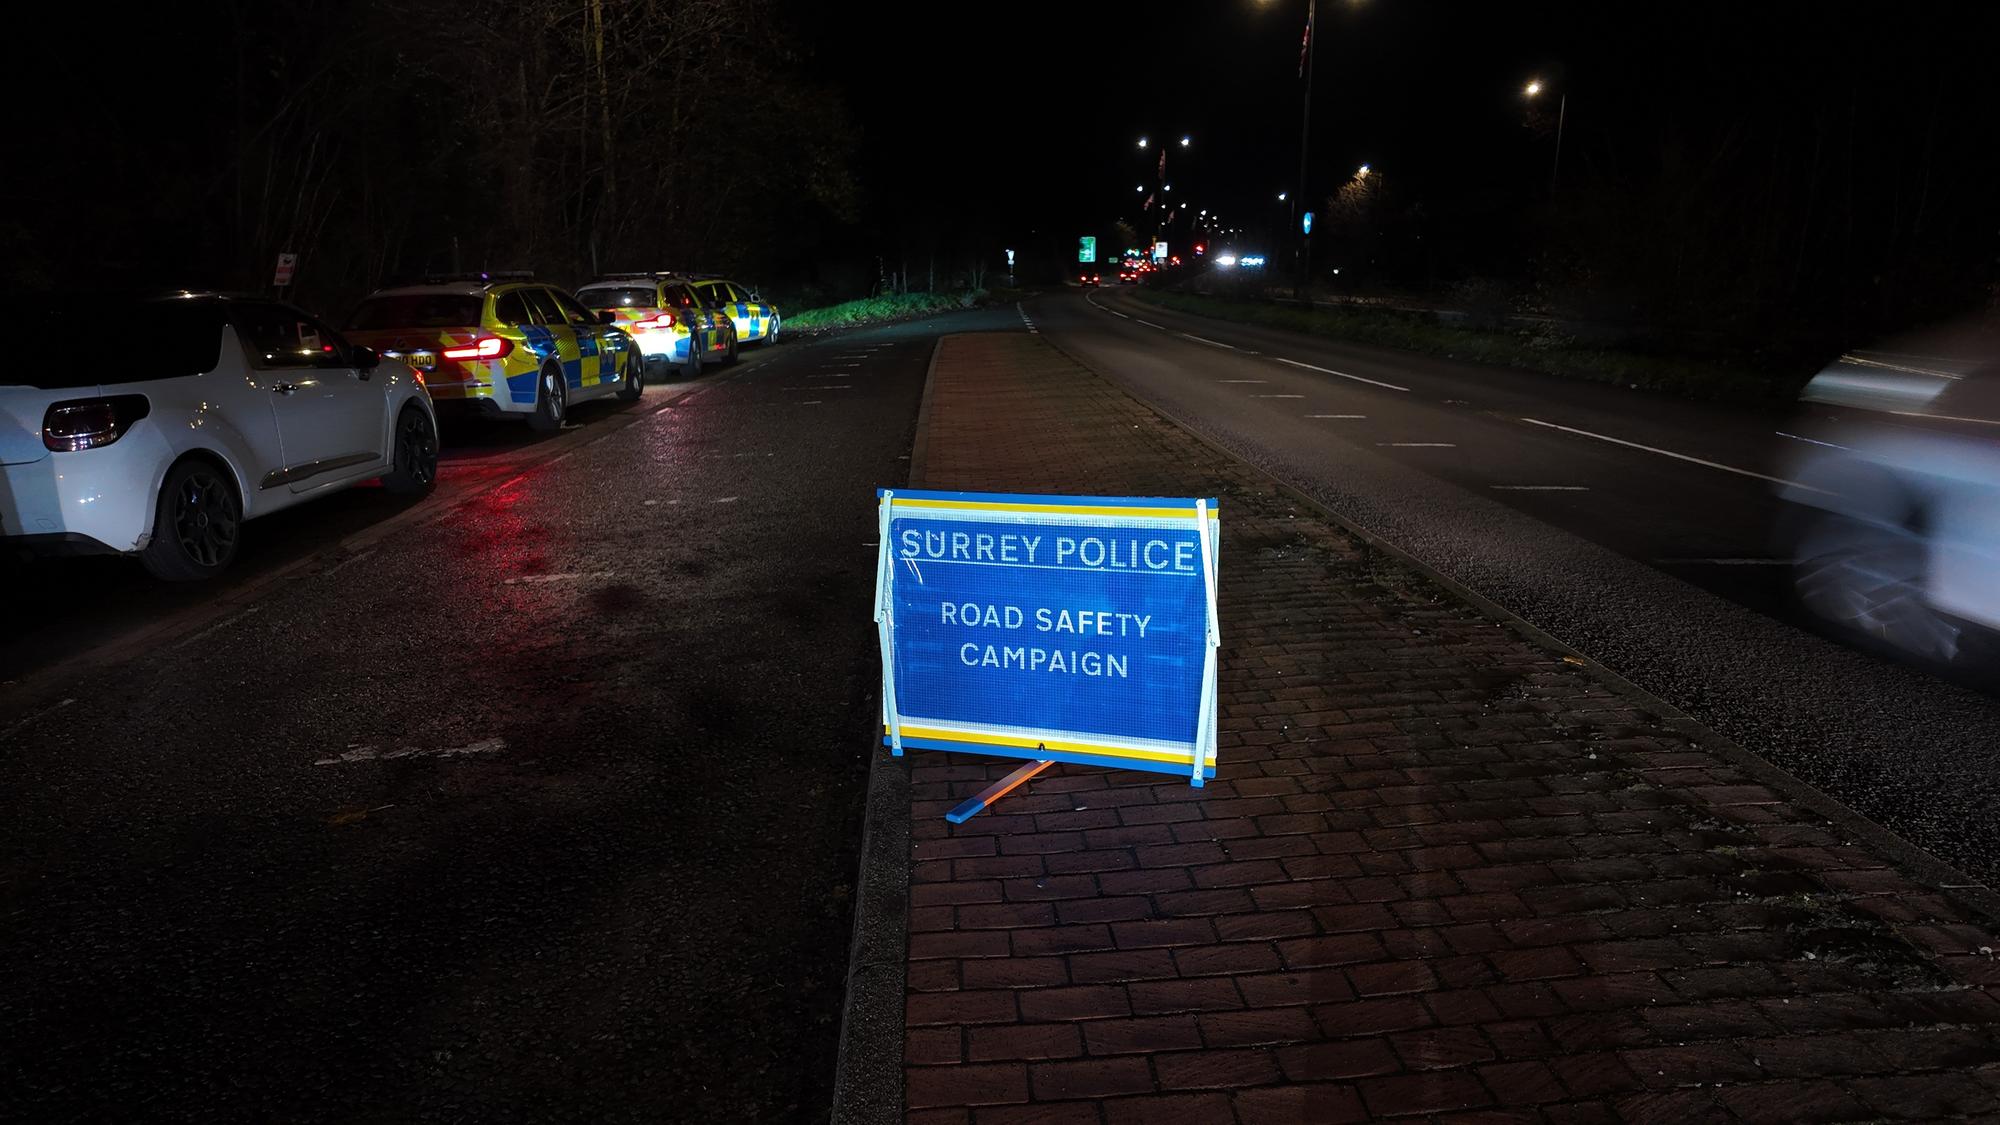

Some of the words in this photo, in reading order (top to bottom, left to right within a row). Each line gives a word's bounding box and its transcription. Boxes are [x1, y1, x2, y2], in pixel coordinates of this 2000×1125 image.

[901, 529, 1042, 563] SURREY
[1057, 536, 1195, 571] POLICE
[941, 601, 1024, 630] ROAD
[1035, 608, 1151, 638] SAFETY
[960, 642, 1128, 678] CAMPAIGN
